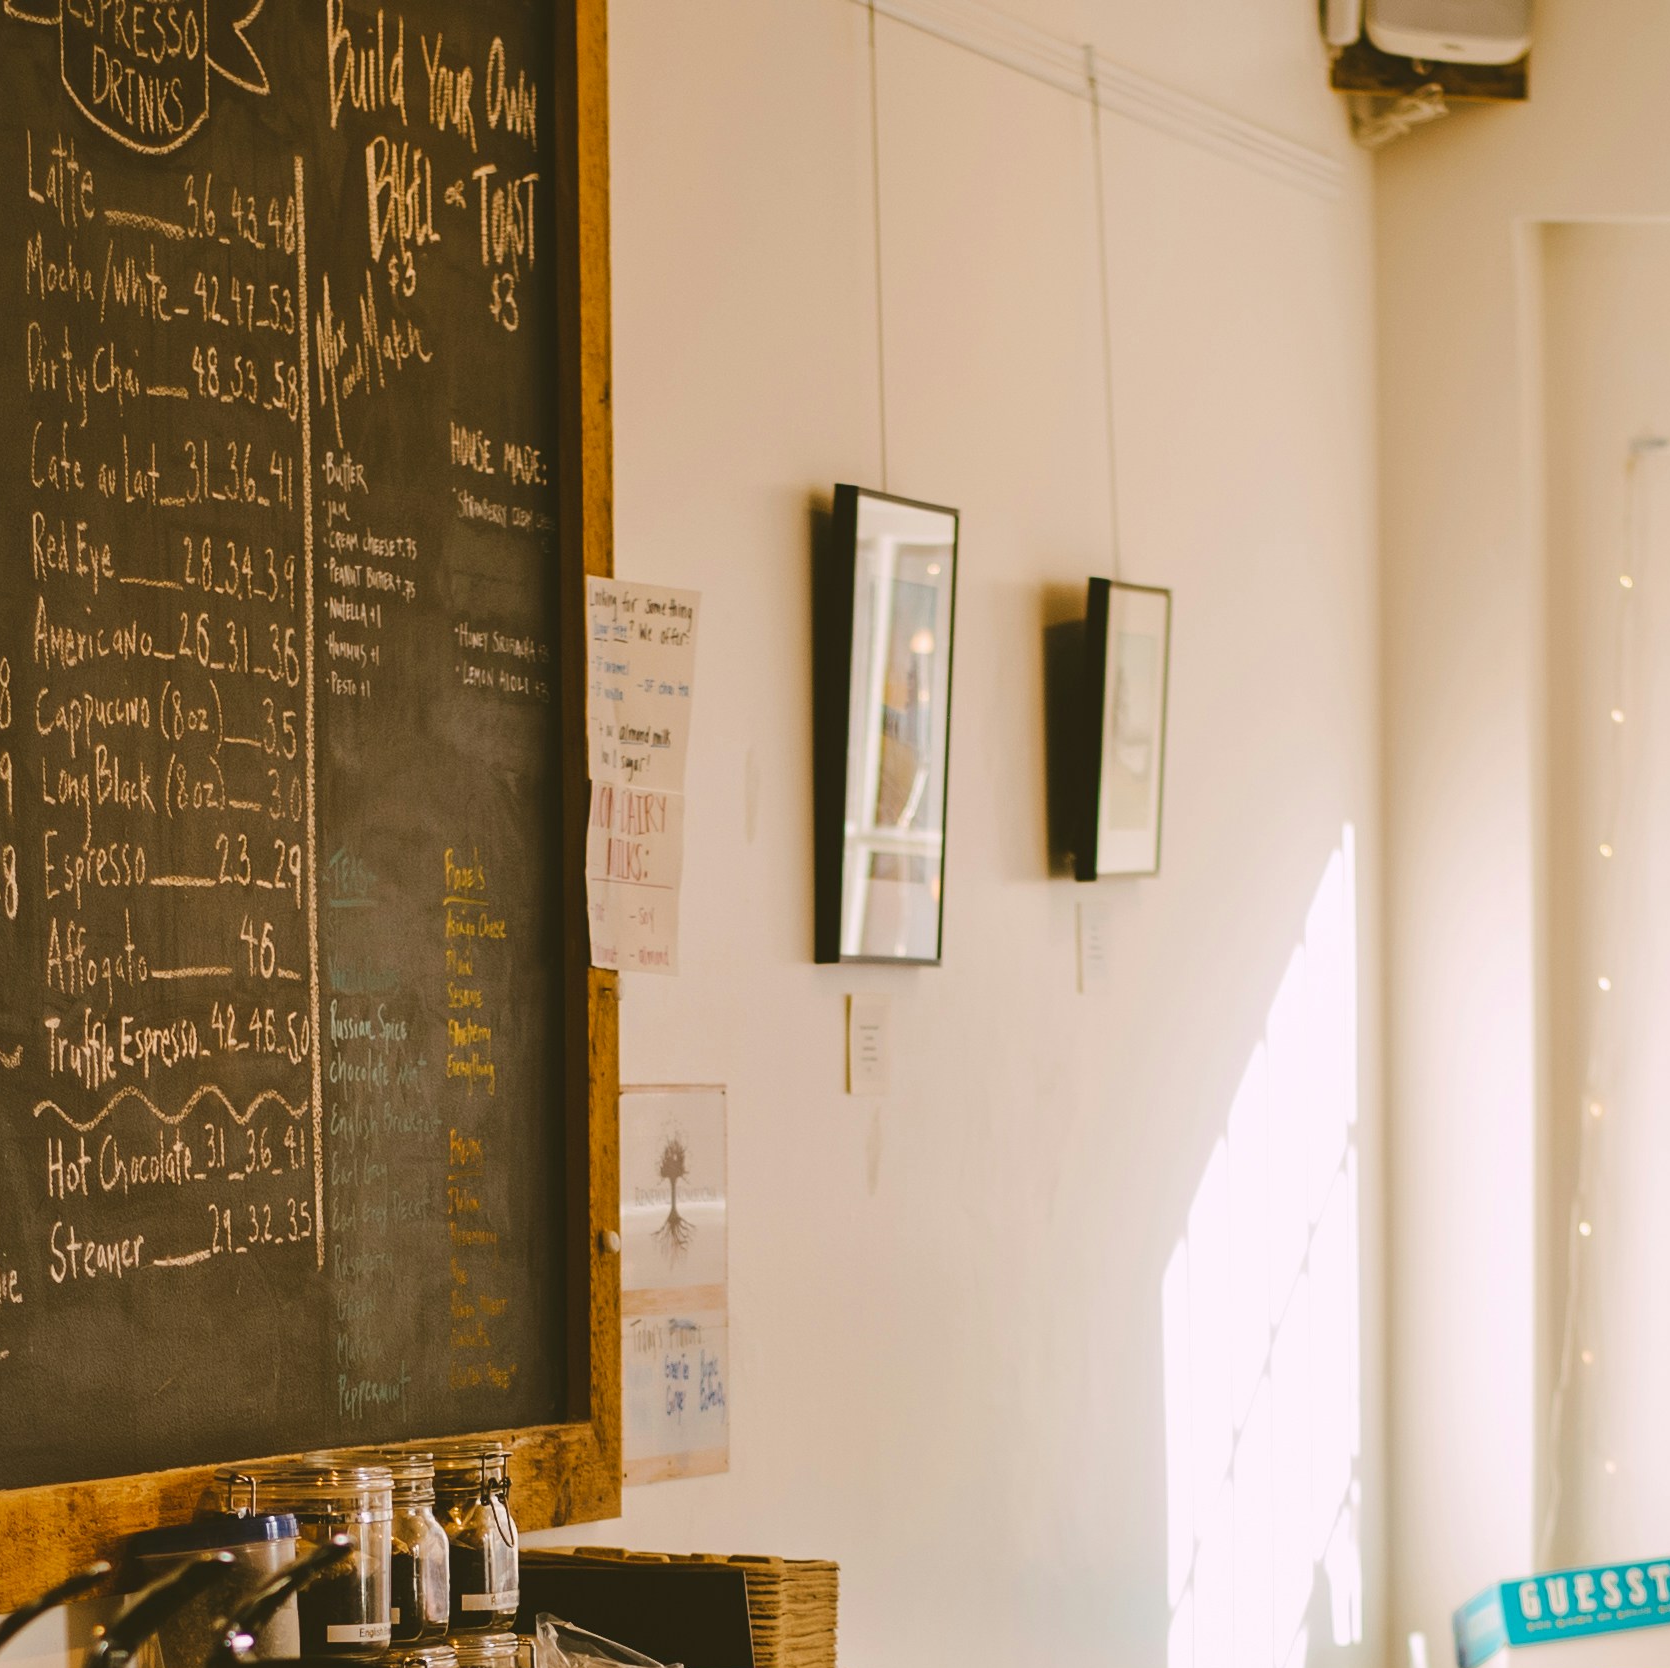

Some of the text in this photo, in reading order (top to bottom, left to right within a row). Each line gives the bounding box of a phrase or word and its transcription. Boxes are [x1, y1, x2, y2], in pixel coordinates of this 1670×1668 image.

[93, 44, 185, 136] DRINKS
[27, 130, 95, 237] Latte
[32, 512, 69, 582] Red
[76, 520, 115, 595] Eye
[45, 830, 146, 910] Espresso
[48, 1136, 91, 1200] Hot
[99, 1130, 192, 1195] Chocolate
